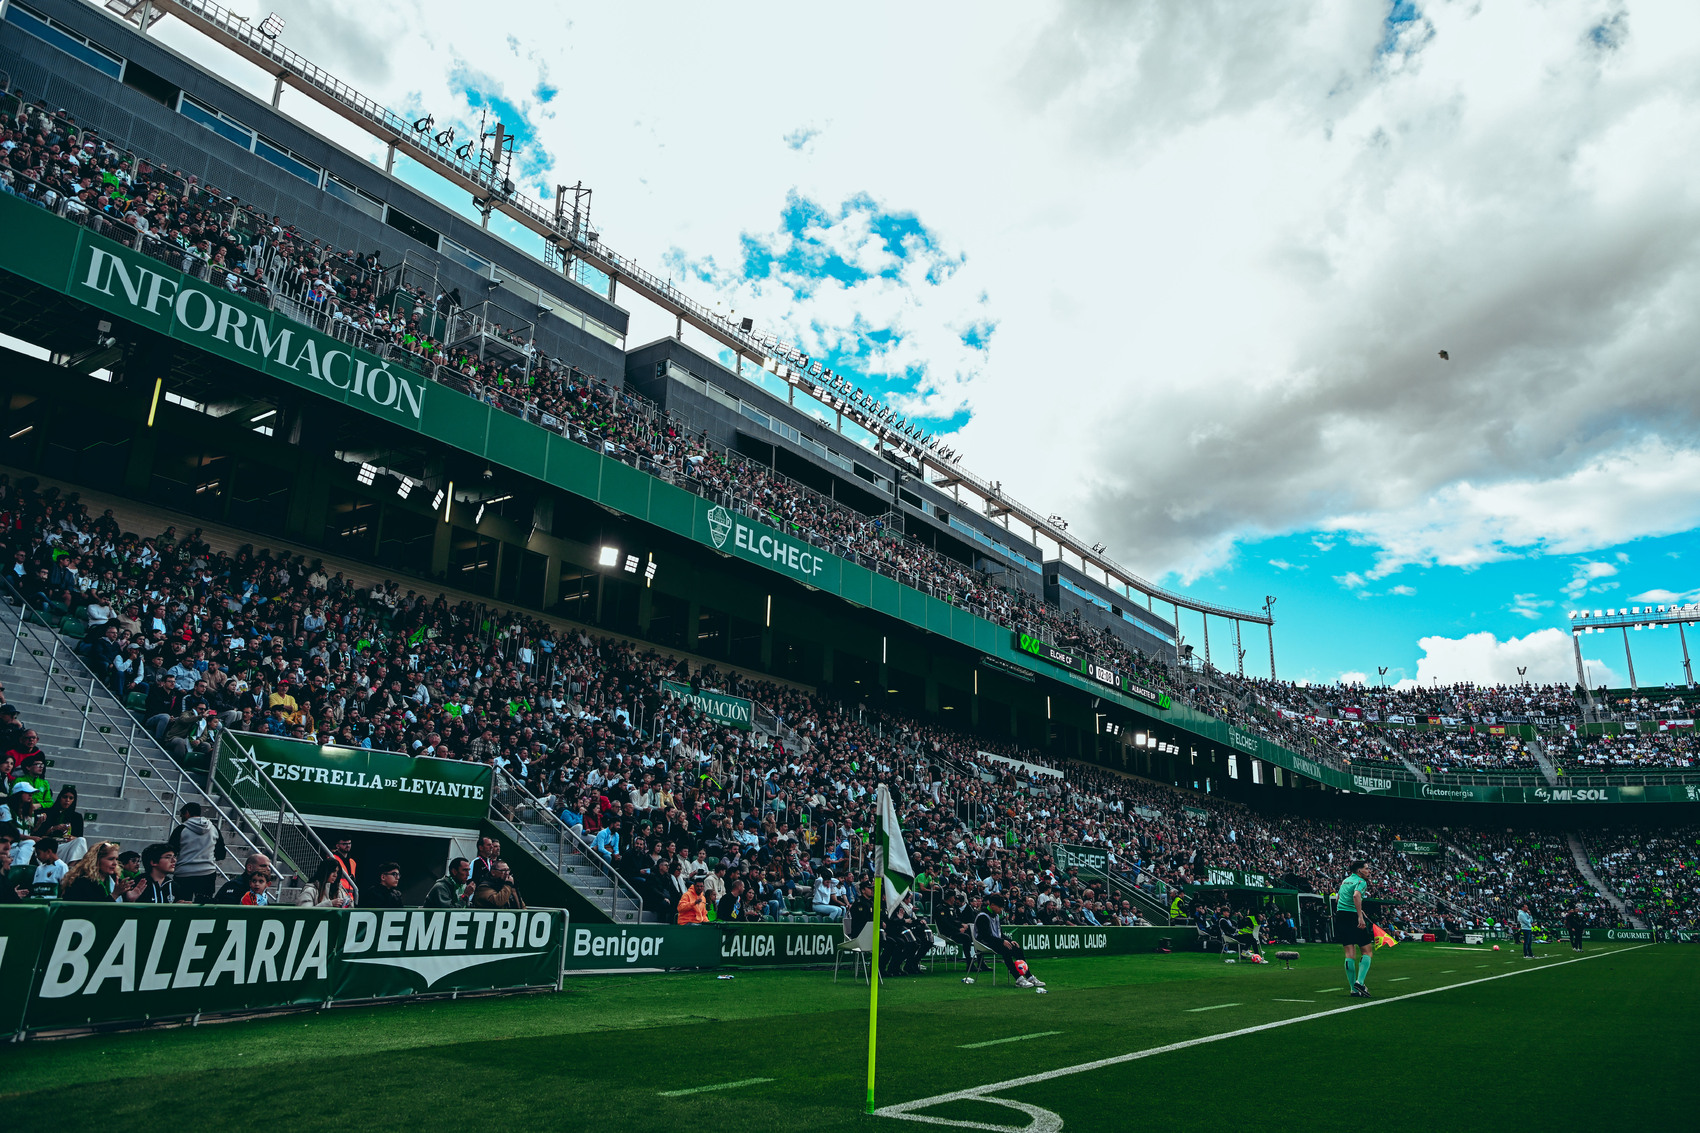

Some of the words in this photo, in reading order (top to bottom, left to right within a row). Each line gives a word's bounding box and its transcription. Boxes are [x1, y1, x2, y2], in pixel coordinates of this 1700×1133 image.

[81, 245, 426, 419] INFORMACIÓN
[1050, 649, 1065, 662] ELCHE
[1065, 656, 1073, 664] CF
[272, 762, 384, 790] ESTRELLA
[385, 779, 398, 789] DE
[400, 777, 484, 801] LEVANTE
[1354, 775, 1391, 790] DEMETRIO
[1553, 789, 1608, 801] MI-SOL
[343, 912, 551, 953] DEMETRIO
[1022, 934, 1050, 950] LALIGA
[1054, 934, 1080, 950] LALIGA
[1084, 933, 1107, 949] LALIGA
[1617, 931, 1651, 939] GOURMET
[573, 929, 664, 963] Benigar
[721, 934, 775, 957] LALIGA
[786, 934, 834, 956] LALIGA
